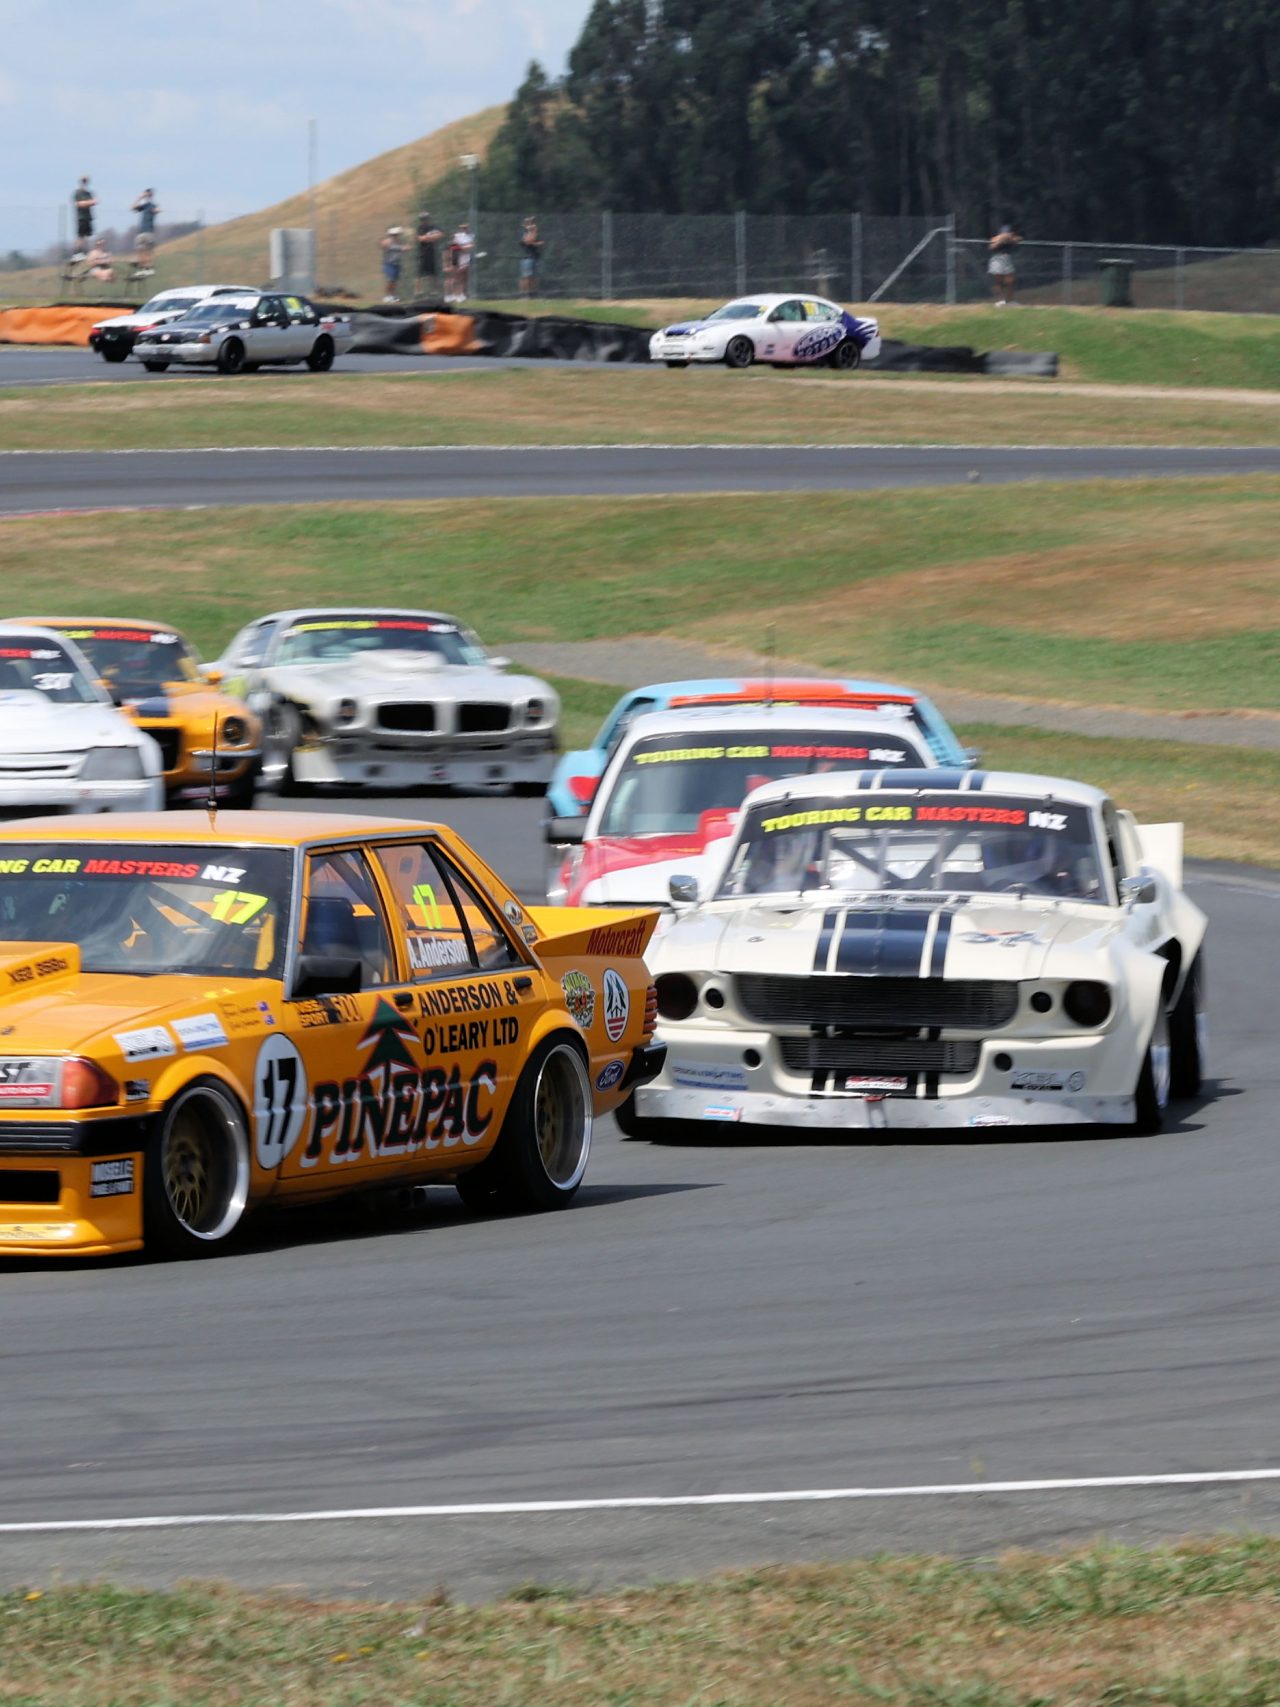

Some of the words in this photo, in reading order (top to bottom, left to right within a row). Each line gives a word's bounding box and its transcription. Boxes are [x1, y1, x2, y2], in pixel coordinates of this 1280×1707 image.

[761, 807, 861, 833] TOURING
[865, 806, 912, 821] CAR
[916, 807, 1025, 825] MASTERS
[1028, 811, 1068, 831] NZ
[32, 859, 80, 873] CAR
[83, 860, 200, 878] MASTERS
[201, 865, 246, 883] NZ
[211, 890, 268, 924] 17
[412, 884, 442, 929] 17
[586, 919, 646, 955] Motorcraft
[418, 982, 503, 1018] ANDERSON
[503, 980, 519, 1005] &
[424, 1020, 489, 1056] O'LEARY
[492, 1017, 519, 1047] LTD
[263, 1057, 297, 1145] 17
[299, 1059, 497, 1168] PINEPAC
